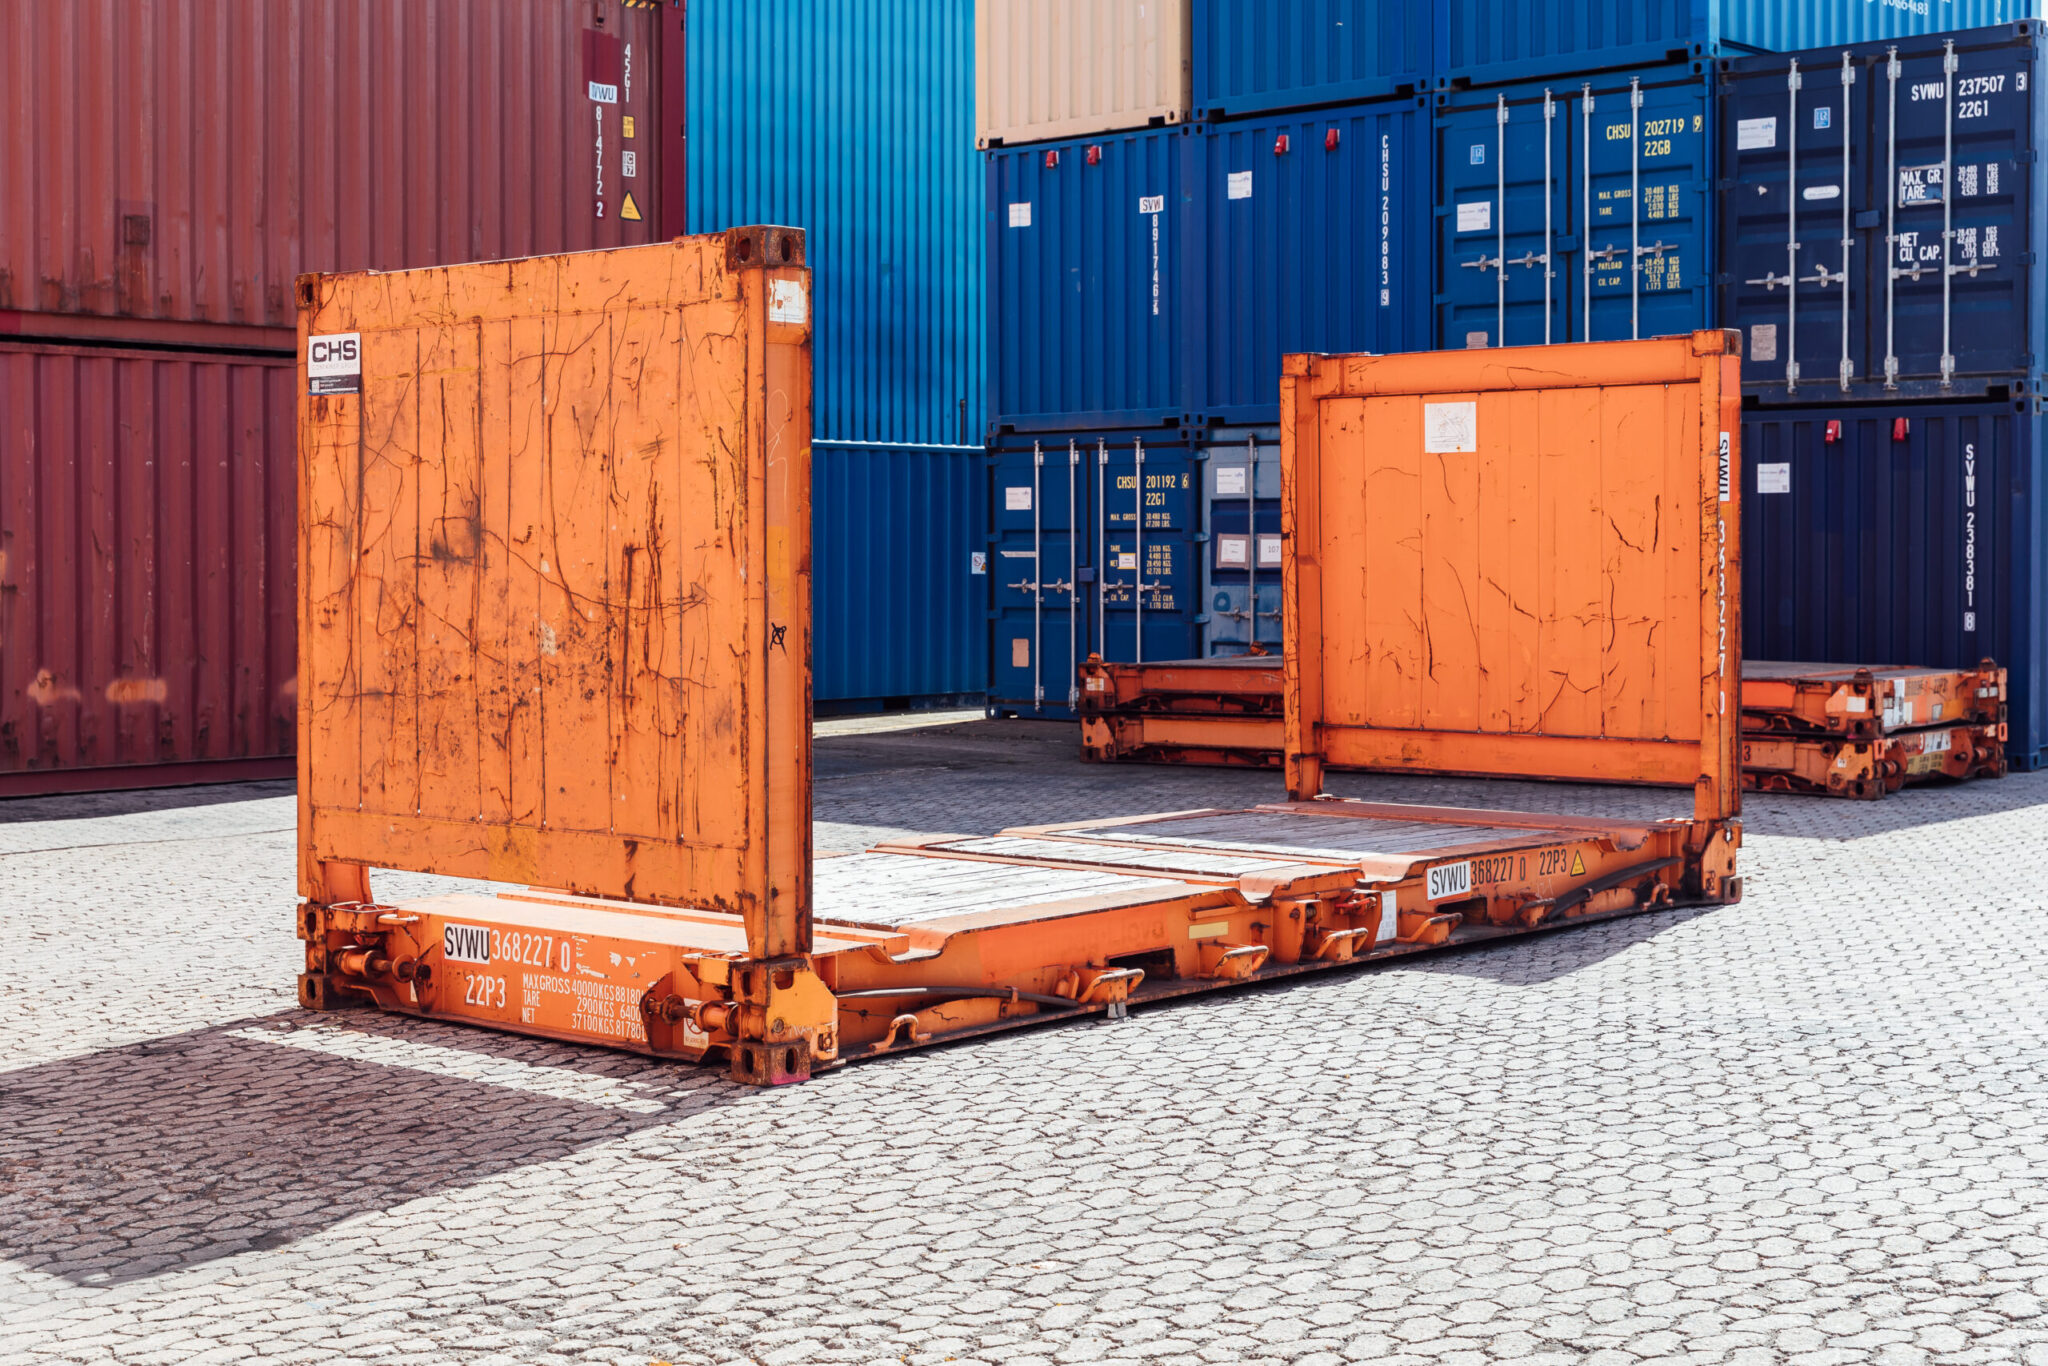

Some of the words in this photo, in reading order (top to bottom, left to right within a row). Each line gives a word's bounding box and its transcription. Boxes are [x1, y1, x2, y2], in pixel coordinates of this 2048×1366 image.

[1911, 81, 1944, 101] SVWU
[1958, 74, 2005, 97] 237507
[2016, 72, 2027, 91] 3
[1958, 99, 1988, 119] 22G1
[1607, 123, 1631, 140] CHSU
[1644, 118, 1685, 137] 202719
[1693, 115, 1702, 132] 9
[595, 106, 603, 195] 814772
[1644, 139, 1671, 157] 22GB
[1900, 170, 1923, 186] MAX.
[1927, 168, 1943, 184] GR.
[1902, 184, 1926, 200] TARE
[596, 201, 604, 218] 2
[1599, 206, 1612, 216] TARE
[1899, 232, 1919, 247] NET
[1899, 247, 1915, 262] CU.
[1920, 245, 1942, 260] CAP.
[1598, 261, 1623, 271] PAYLOAD
[312, 339, 357, 363] CHS
[1117, 475, 1137, 489] CHSU
[1146, 475, 1176, 489] 201192
[1182, 473, 1189, 488] 6
[1965, 443, 1975, 508] SVWU
[1146, 492, 1165, 506] 22G1
[1965, 511, 1975, 607] 238381
[1964, 612, 1975, 631] 8
[1431, 864, 1467, 895] SVWU
[1471, 856, 1514, 886] 368227
[1519, 856, 1526, 881] 0
[1539, 849, 1567, 876] 22P3
[444, 926, 490, 961] SVWU
[491, 929, 553, 968] 368227
[560, 941, 571, 973] 0
[465, 974, 506, 1008] 22P3
[523, 990, 541, 1007] TARE
[522, 1007, 535, 1024] NET
